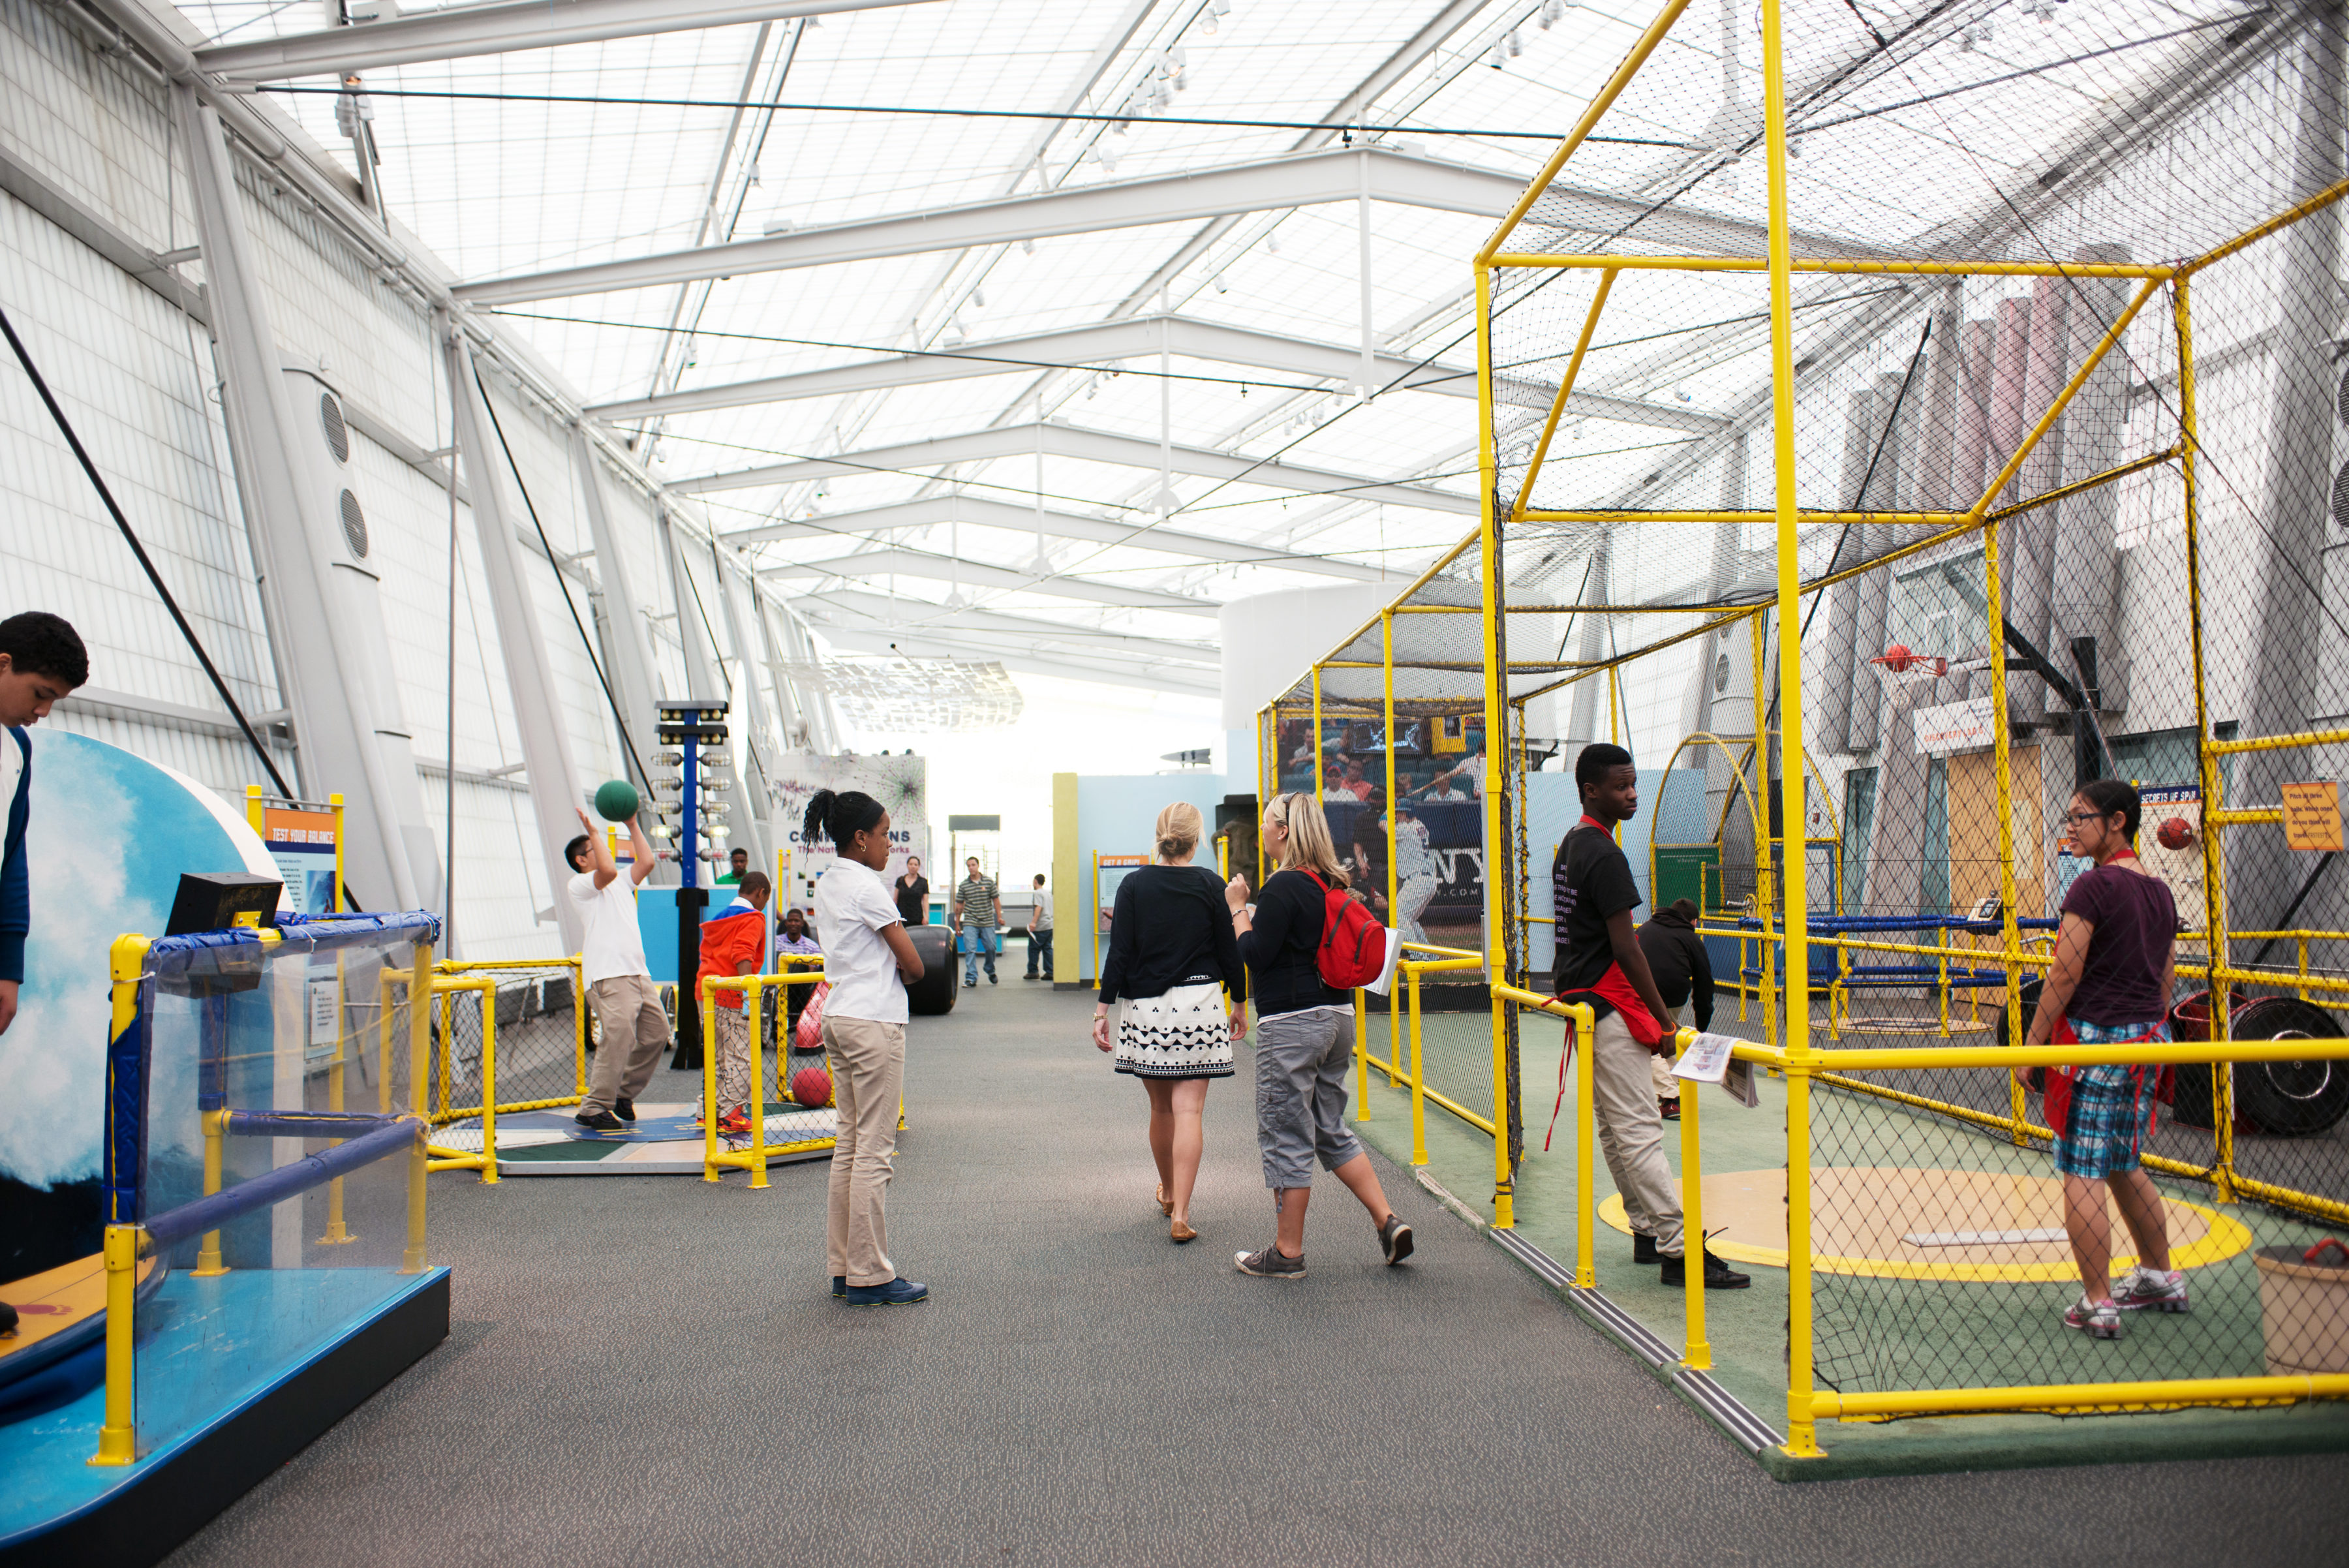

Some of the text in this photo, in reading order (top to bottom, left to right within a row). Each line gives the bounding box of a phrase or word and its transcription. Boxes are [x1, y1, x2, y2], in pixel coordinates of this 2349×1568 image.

[2141, 790, 2196, 804] SECRETS OF SPIN
[273, 827, 335, 844] TEST YOUR BALANCE
